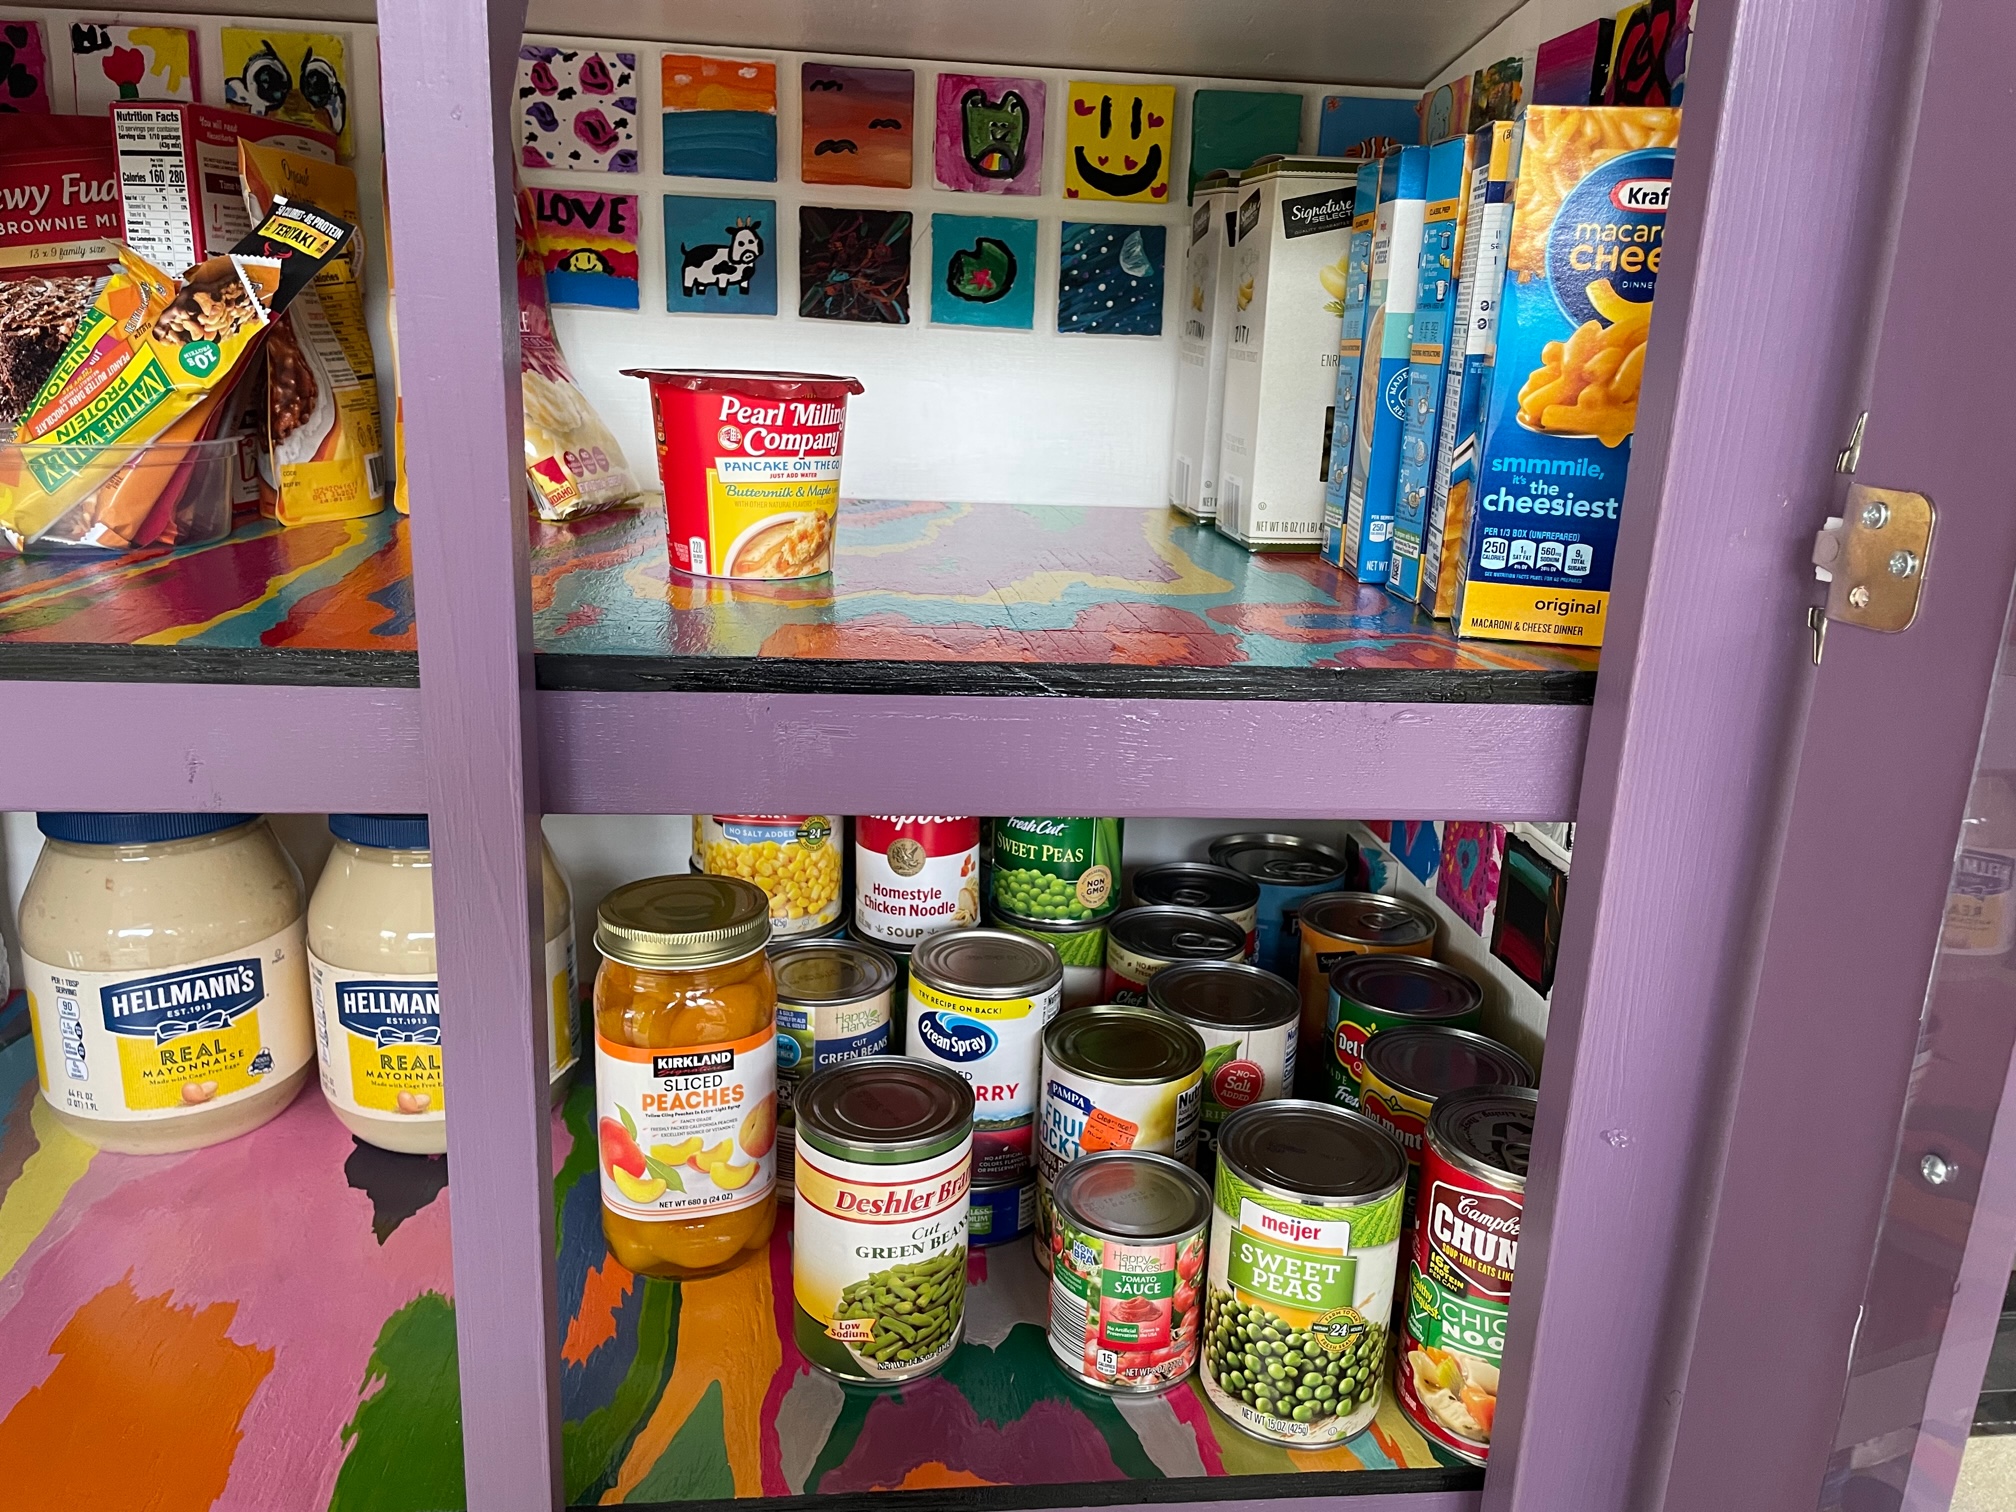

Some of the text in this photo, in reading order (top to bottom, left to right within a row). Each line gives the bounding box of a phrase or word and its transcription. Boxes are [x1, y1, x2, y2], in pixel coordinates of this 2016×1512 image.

[116, 111, 179, 122] Nutrition Facts
[125, 125, 146, 133] servings
[122, 169, 185, 184] Calories 160 280
[0, 172, 119, 216] wy Fud
[1627, 187, 1670, 205] Kraf
[95, 213, 118, 228] MI
[536, 190, 628, 234] LOVE
[1291, 199, 1354, 224] Signature
[1311, 210, 1352, 223] SELECT
[272, 223, 317, 249] TERIYAKI
[312, 216, 344, 239] PROTEIN
[29, 245, 106, 261] 13 x 9 family size
[1390, 371, 1408, 395] MADE
[35, 352, 130, 435] PEANUT BUTTER DARK CHOCOLATE
[56, 376, 129, 442] PROTEIN
[719, 395, 846, 430] Pearl Milling
[39, 365, 166, 486] NATURE VALLEY
[744, 427, 840, 460] Company
[724, 460, 839, 471] PANCAKE ON THE GO
[1492, 457, 1605, 480] smmmile,
[1513, 475, 1526, 485] it's
[1530, 480, 1559, 496] the
[725, 484, 832, 498] Buttermilk & Maple
[1482, 487, 1619, 519] cheesiest
[1256, 521, 1268, 531] NET
[1270, 522, 1279, 532] WT
[1282, 522, 1288, 532] 16
[1290, 522, 1298, 532] OZ
[1300, 522, 1305, 534] (1
[1307, 522, 1317, 534] LB)
[1484, 528, 1498, 536] PER
[1512, 529, 1527, 538] BOX
[1529, 530, 1581, 542] (UNPREPARED)
[1484, 541, 1506, 554] 250
[1366, 560, 1390, 572] NET WT.
[1535, 598, 1601, 616] original
[1471, 618, 1583, 636] MACARONI & CHEESE DINNER
[730, 828, 794, 838] NO SALT ADDED
[809, 828, 821, 838] 24
[997, 832, 1084, 863] SWEET PEAS
[873, 883, 942, 900] Homestyle
[1086, 886, 1104, 896] GMO
[1087, 878, 1105, 888] NON
[864, 897, 956, 917] Chicken Noodle
[887, 926, 924, 938] SOUP
[111, 966, 255, 1018] HELLMANN'S
[919, 990, 929, 1000] TRY
[931, 996, 956, 1010] RECIPE
[1116, 990, 1143, 1006] Chef
[62, 1001, 72, 1012] 90
[167, 1003, 212, 1018] EST.1913
[344, 992, 439, 1014] HELLMAN
[386, 1017, 428, 1025] EST.1913
[836, 1008, 871, 1024] Happy
[841, 1013, 882, 1034] Harvest
[852, 1038, 867, 1048] CUT
[861, 1036, 888, 1056] BEANS
[921, 1020, 987, 1056] Ocean Spray
[1338, 1032, 1357, 1056] Del
[160, 1039, 227, 1066] REAL
[657, 1052, 732, 1070] KIRKLAND
[142, 1049, 245, 1078] MAYONNAISE
[380, 1054, 440, 1071] REAL
[664, 1074, 723, 1092] SLICED
[1236, 1070, 1250, 1078] NO
[1224, 1076, 1252, 1093] Salt
[642, 1084, 745, 1112] PEACHES
[1052, 1084, 1085, 1108] PAMPA
[1220, 1090, 1250, 1102] ADDED
[1046, 1100, 1083, 1136] FRUI
[835, 1166, 971, 1215] Deshler Bran
[659, 1200, 674, 1208] NET
[674, 1200, 686, 1208] WT
[688, 1198, 701, 1206] 680
[710, 1194, 720, 1204] (24
[722, 1192, 734, 1201] OZ)
[1457, 1195, 1520, 1235] Campbe
[912, 1222, 940, 1240] Cut
[1262, 1214, 1322, 1242] meijer
[1434, 1202, 1518, 1270] CHUN
[856, 1242, 925, 1259] GREEN
[1074, 1240, 1094, 1256] NON
[1114, 1250, 1152, 1264] Happy
[1074, 1249, 1094, 1266] BPA
[1240, 1243, 1341, 1284] SWEET
[1431, 1252, 1450, 1273] 16g
[1442, 1242, 1496, 1278] SOUP THAT EATS
[1118, 1262, 1164, 1272] Harvest
[1430, 1261, 1464, 1289] PROTEIN
[1121, 1275, 1157, 1283] TOMATO
[1251, 1267, 1322, 1302] PEAS
[1429, 1269, 1458, 1292] PER CAN
[1114, 1282, 1162, 1295] SAUCE
[1412, 1286, 1437, 1320] Request
[1324, 1310, 1341, 1322] FARM
[1350, 1312, 1358, 1322] CAN
[1442, 1302, 1507, 1336] CHIC
[831, 1329, 869, 1339] Sodium
[839, 1322, 860, 1330] Low
[1106, 1330, 1138, 1338] Preservatives
[1330, 1323, 1348, 1336] 24
[1320, 1338, 1352, 1350] FRESH SEAL
[1442, 1320, 1504, 1351] NOO
[1102, 1352, 1112, 1364] 15
[1126, 1368, 1150, 1376] NET WT
[1242, 1407, 1309, 1436] NET WT 15 OZ (425g)
